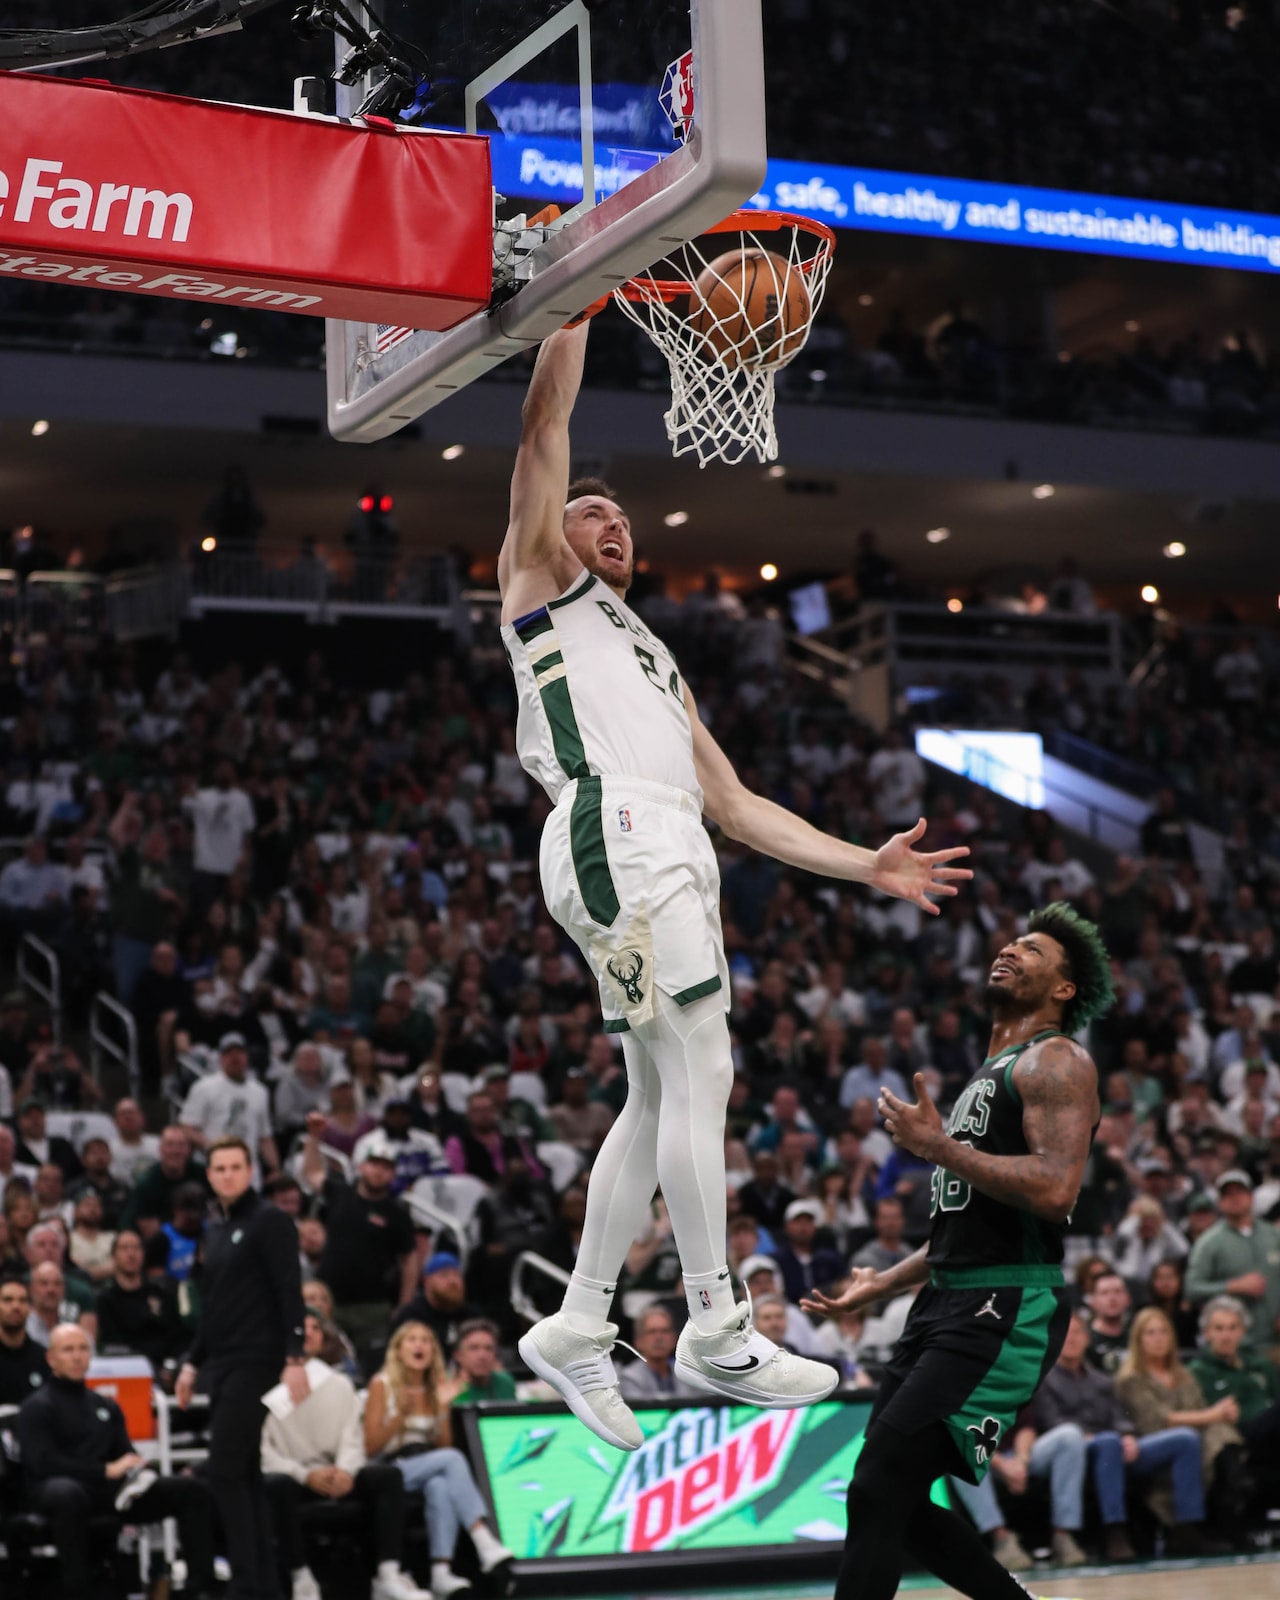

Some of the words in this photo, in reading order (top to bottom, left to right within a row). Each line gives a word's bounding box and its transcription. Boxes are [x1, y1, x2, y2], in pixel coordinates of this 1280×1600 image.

[13, 157, 194, 242] Farm
[775, 177, 848, 219] safe,
[853, 181, 961, 231] healthy
[965, 199, 1021, 231] and
[1024, 208, 1179, 249] sustainable
[0, 252, 143, 286] tate
[138, 273, 323, 309] Farm
